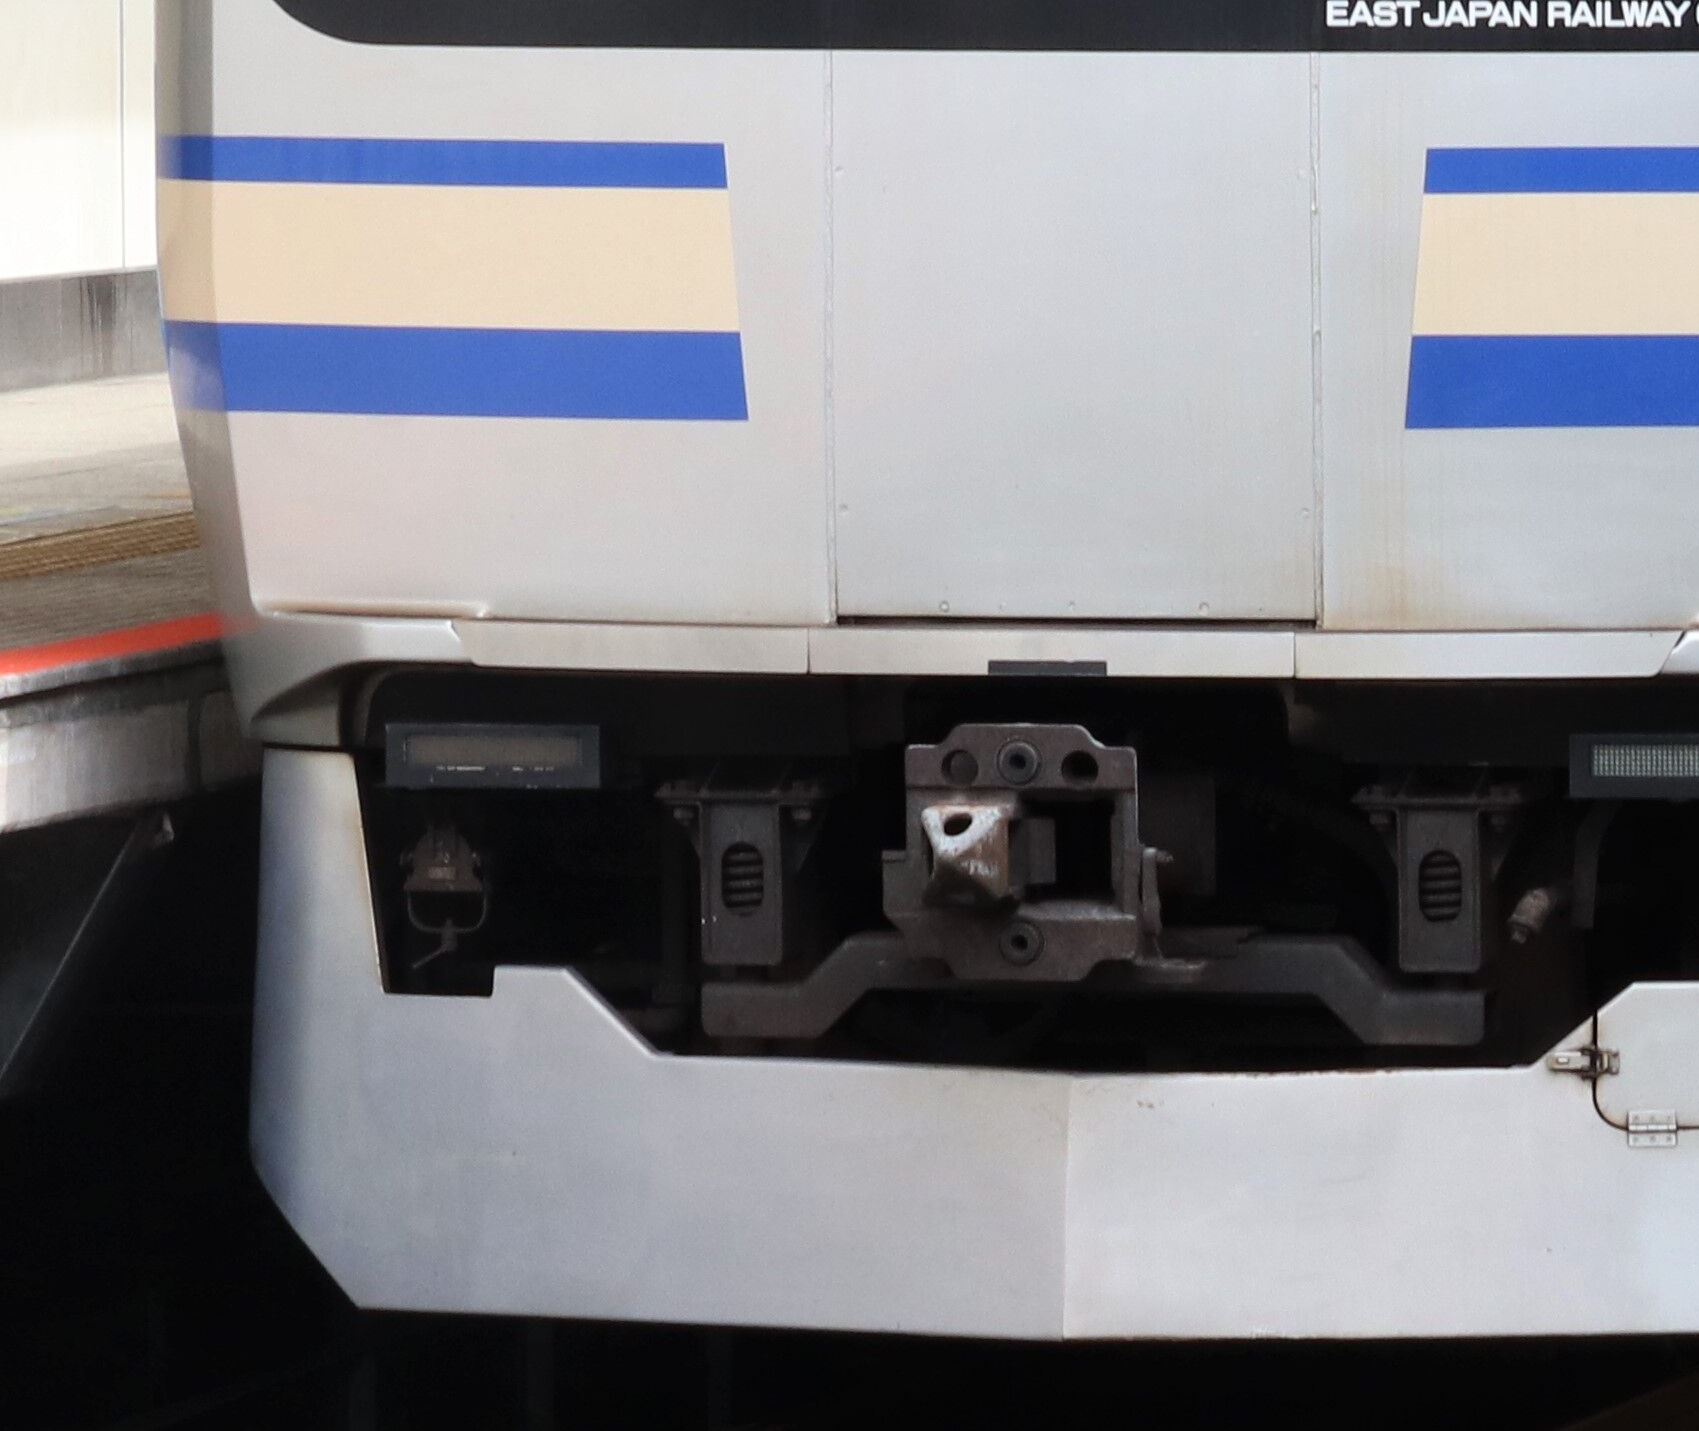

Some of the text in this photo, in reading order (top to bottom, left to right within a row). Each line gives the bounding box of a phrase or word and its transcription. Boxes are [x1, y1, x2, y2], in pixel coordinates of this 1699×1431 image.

[1326, 0, 1420, 28] EAST
[1423, 0, 1538, 28] JAPAN
[1547, 0, 1690, 28] RAILWAY
